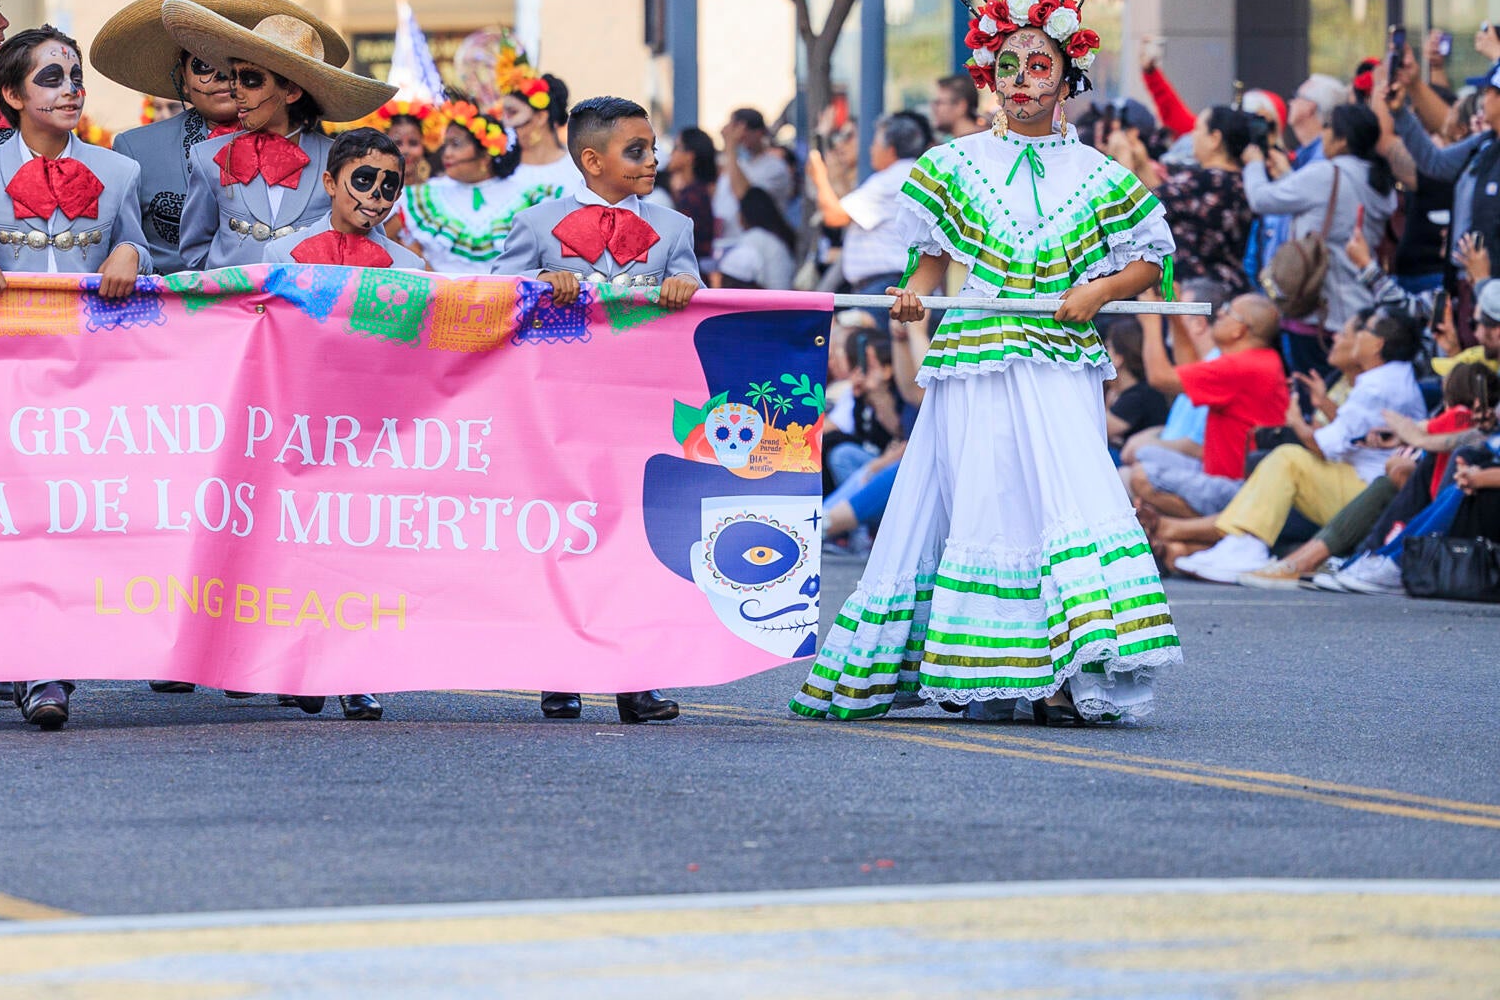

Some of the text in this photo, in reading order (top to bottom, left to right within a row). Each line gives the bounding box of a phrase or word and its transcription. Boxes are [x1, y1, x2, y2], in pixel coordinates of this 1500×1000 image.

[9, 402, 493, 475] GRAND PARADE
[45, 475, 129, 534] DE
[154, 477, 255, 537] LOS
[276, 489, 599, 555] MUERTOS
[94, 574, 407, 631] LONG BEACH
